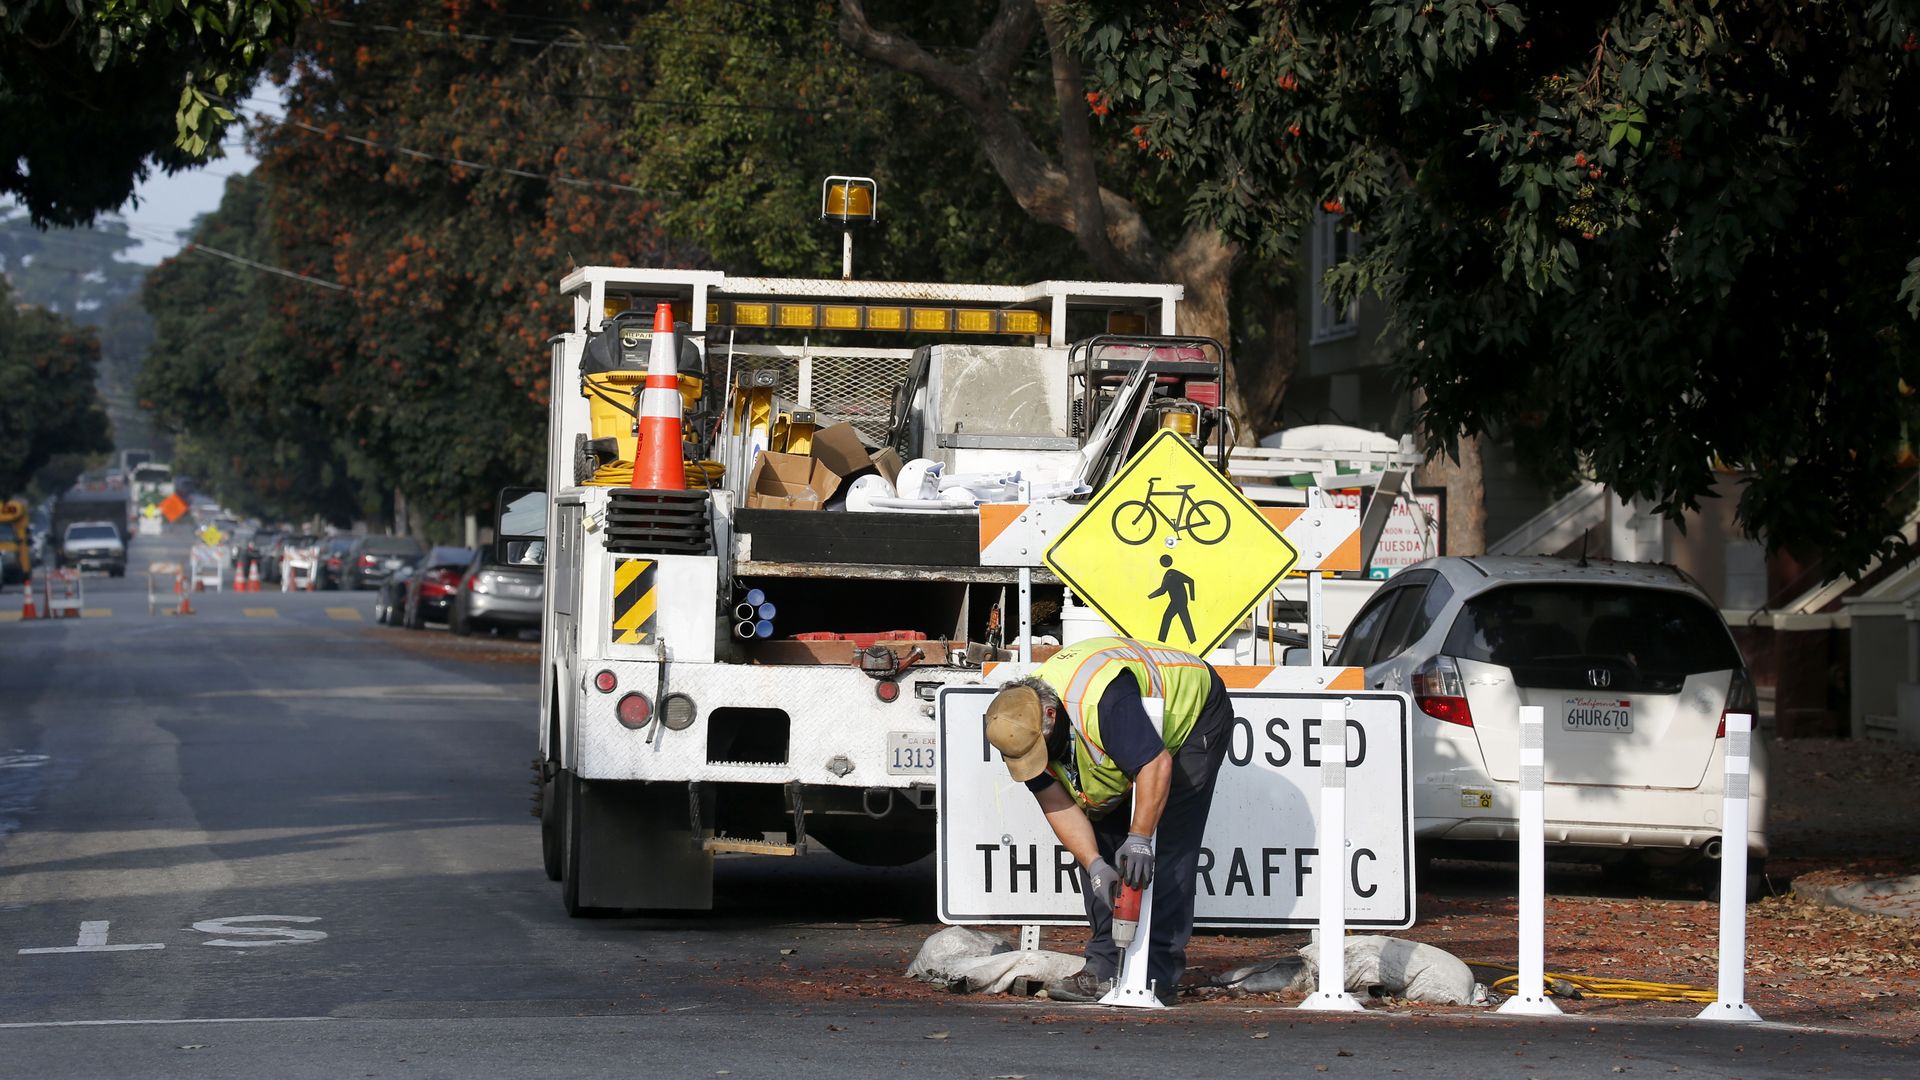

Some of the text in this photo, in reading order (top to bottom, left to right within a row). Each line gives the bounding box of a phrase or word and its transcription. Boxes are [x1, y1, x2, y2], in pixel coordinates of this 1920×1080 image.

[1380, 541, 1421, 551] TUESDA
[1567, 708, 1629, 728] 6HUR670
[1227, 716, 1367, 767] OSED
[893, 747, 935, 768] 1313
[975, 844, 1378, 899] THR RAFFC
